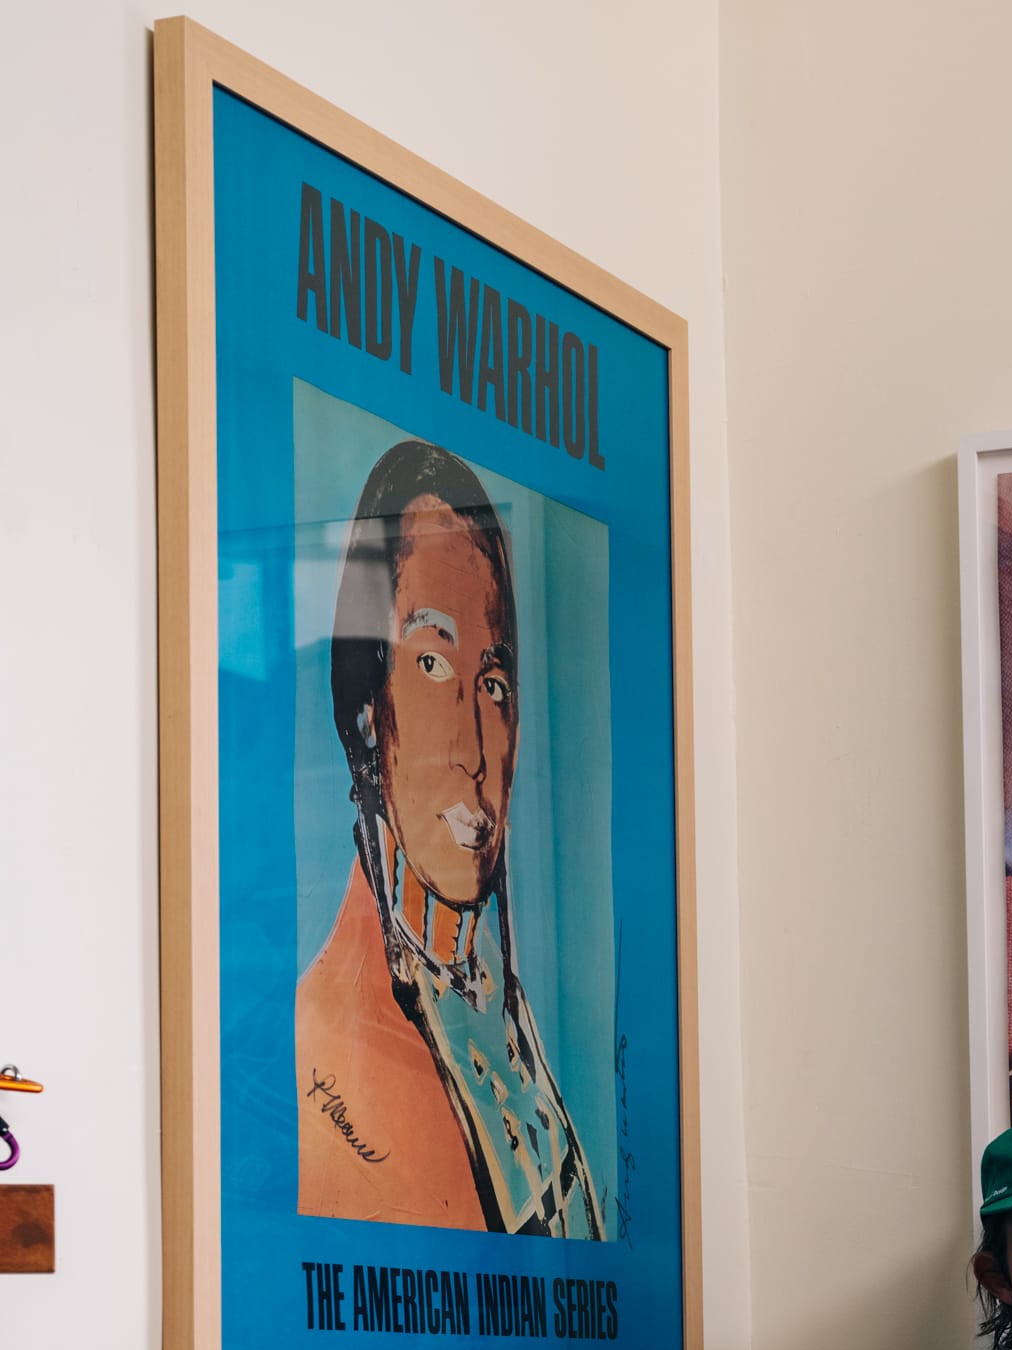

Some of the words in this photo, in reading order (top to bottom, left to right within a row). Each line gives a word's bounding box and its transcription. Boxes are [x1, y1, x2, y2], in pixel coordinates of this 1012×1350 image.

[296, 181, 422, 376] ANDY
[433, 255, 606, 472] WARHOL
[302, 1262, 346, 1331] THE
[353, 1264, 471, 1336] AMERICAN
[476, 1273, 548, 1338] INDIAN
[552, 1277, 619, 1341] SERIES
